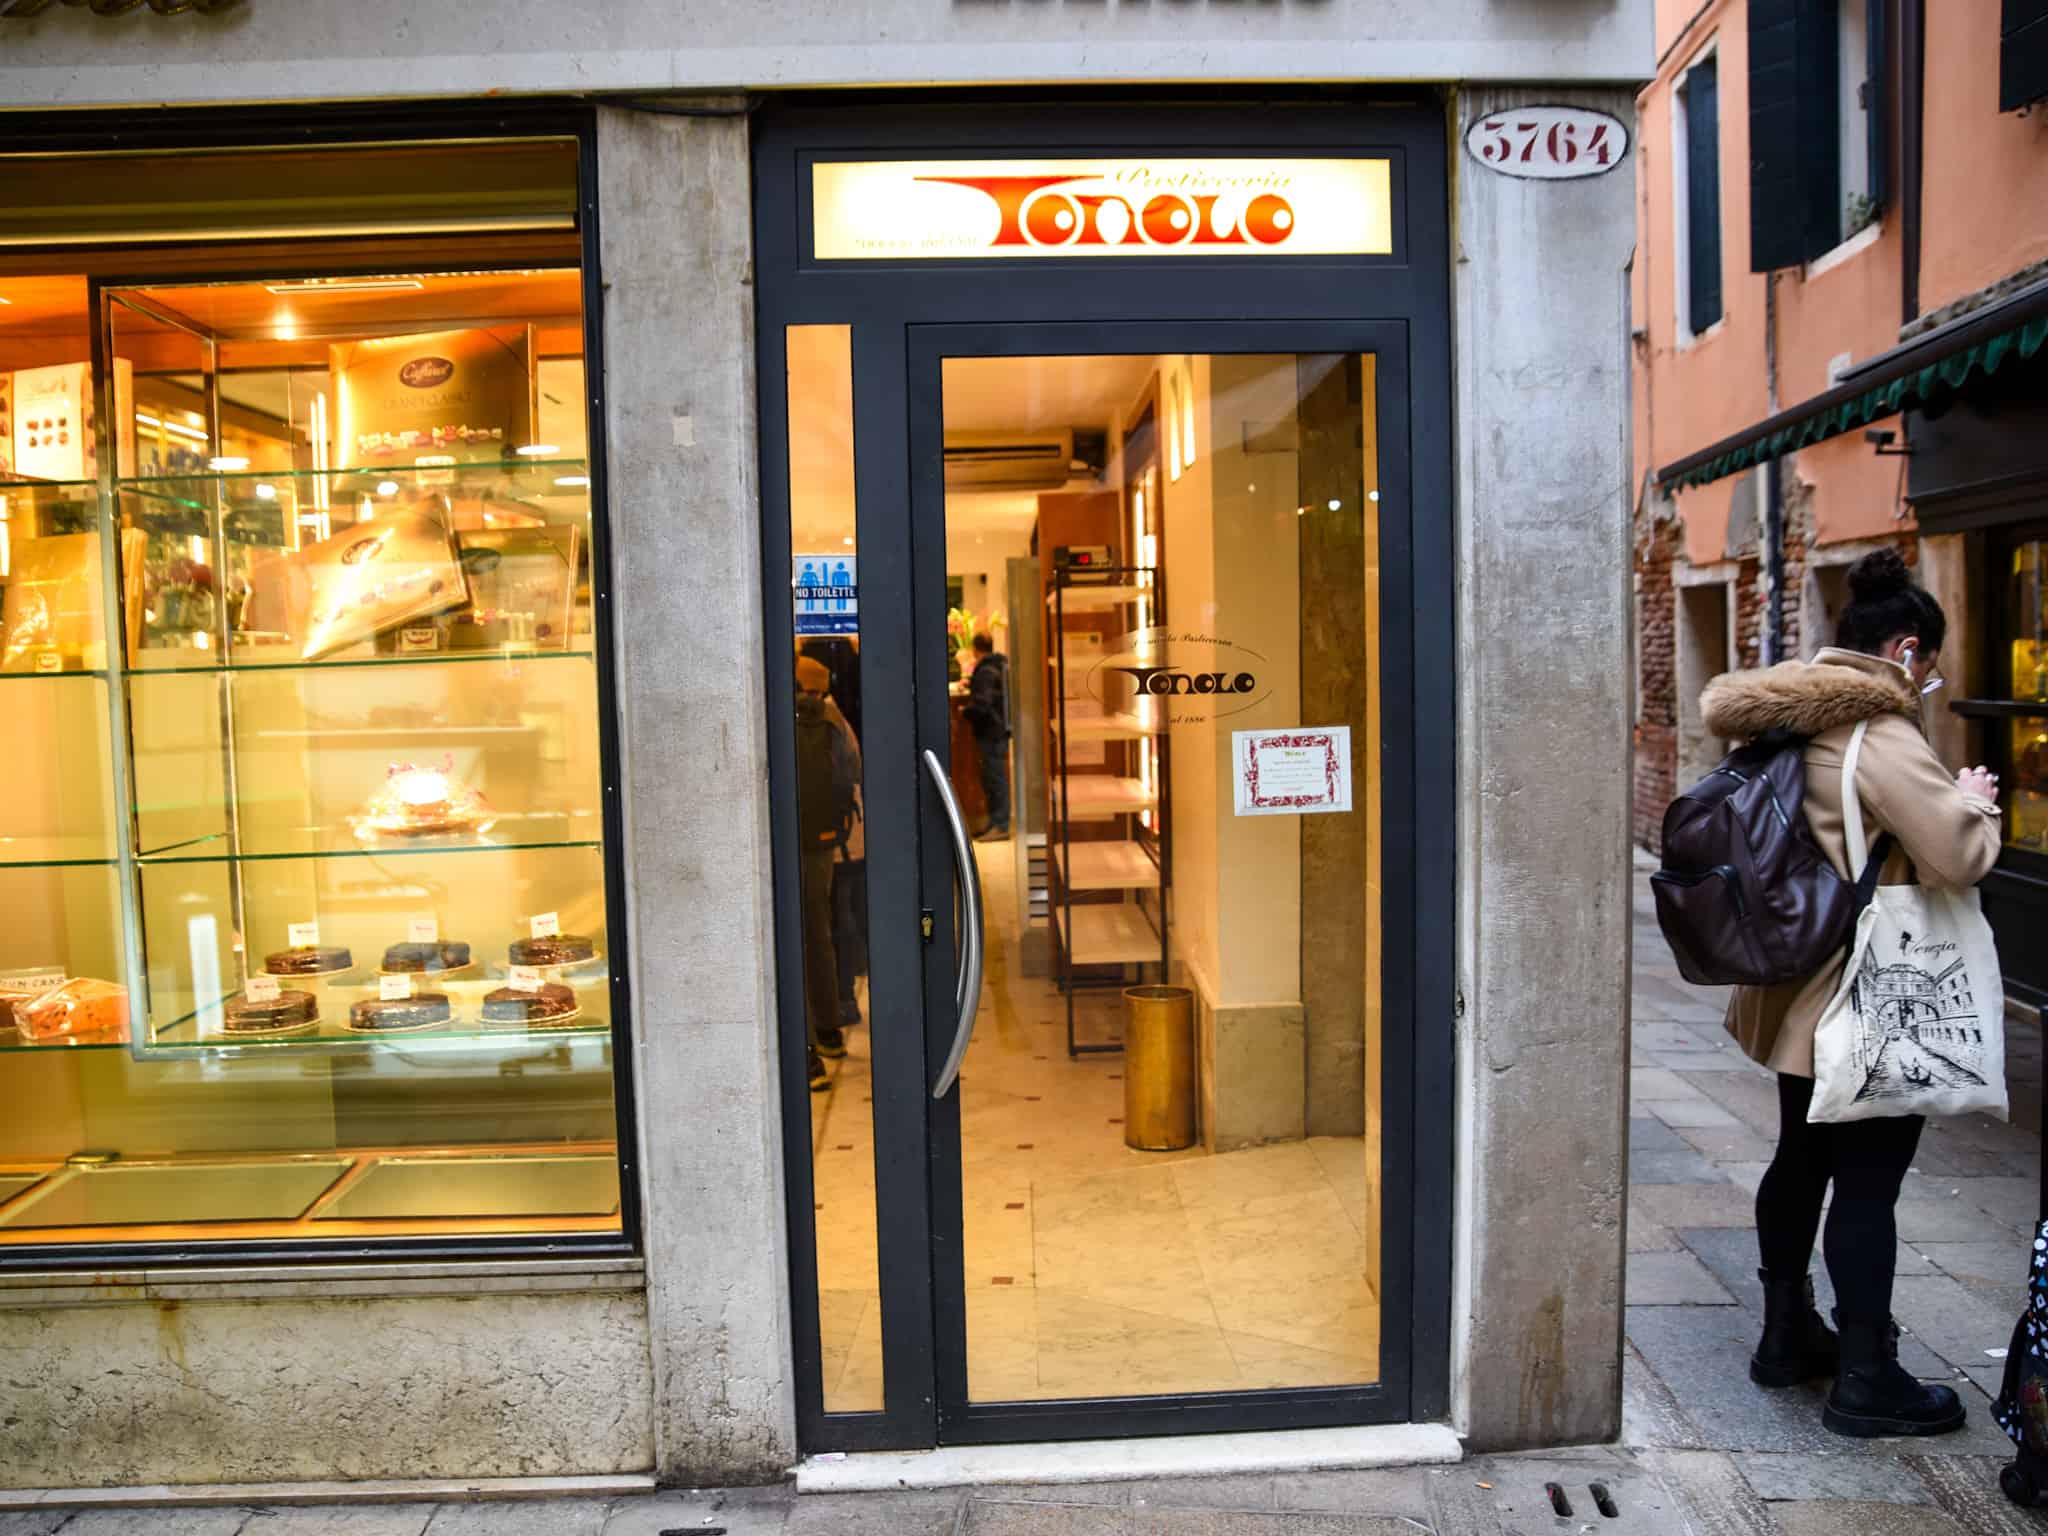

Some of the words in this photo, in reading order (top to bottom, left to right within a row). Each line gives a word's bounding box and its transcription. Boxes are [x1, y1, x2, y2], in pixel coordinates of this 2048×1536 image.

[1482, 121, 1610, 165] 3764
[1116, 167, 1292, 187] Pasticceria
[796, 587, 809, 598] NO
[812, 587, 855, 598] TOILETTE
